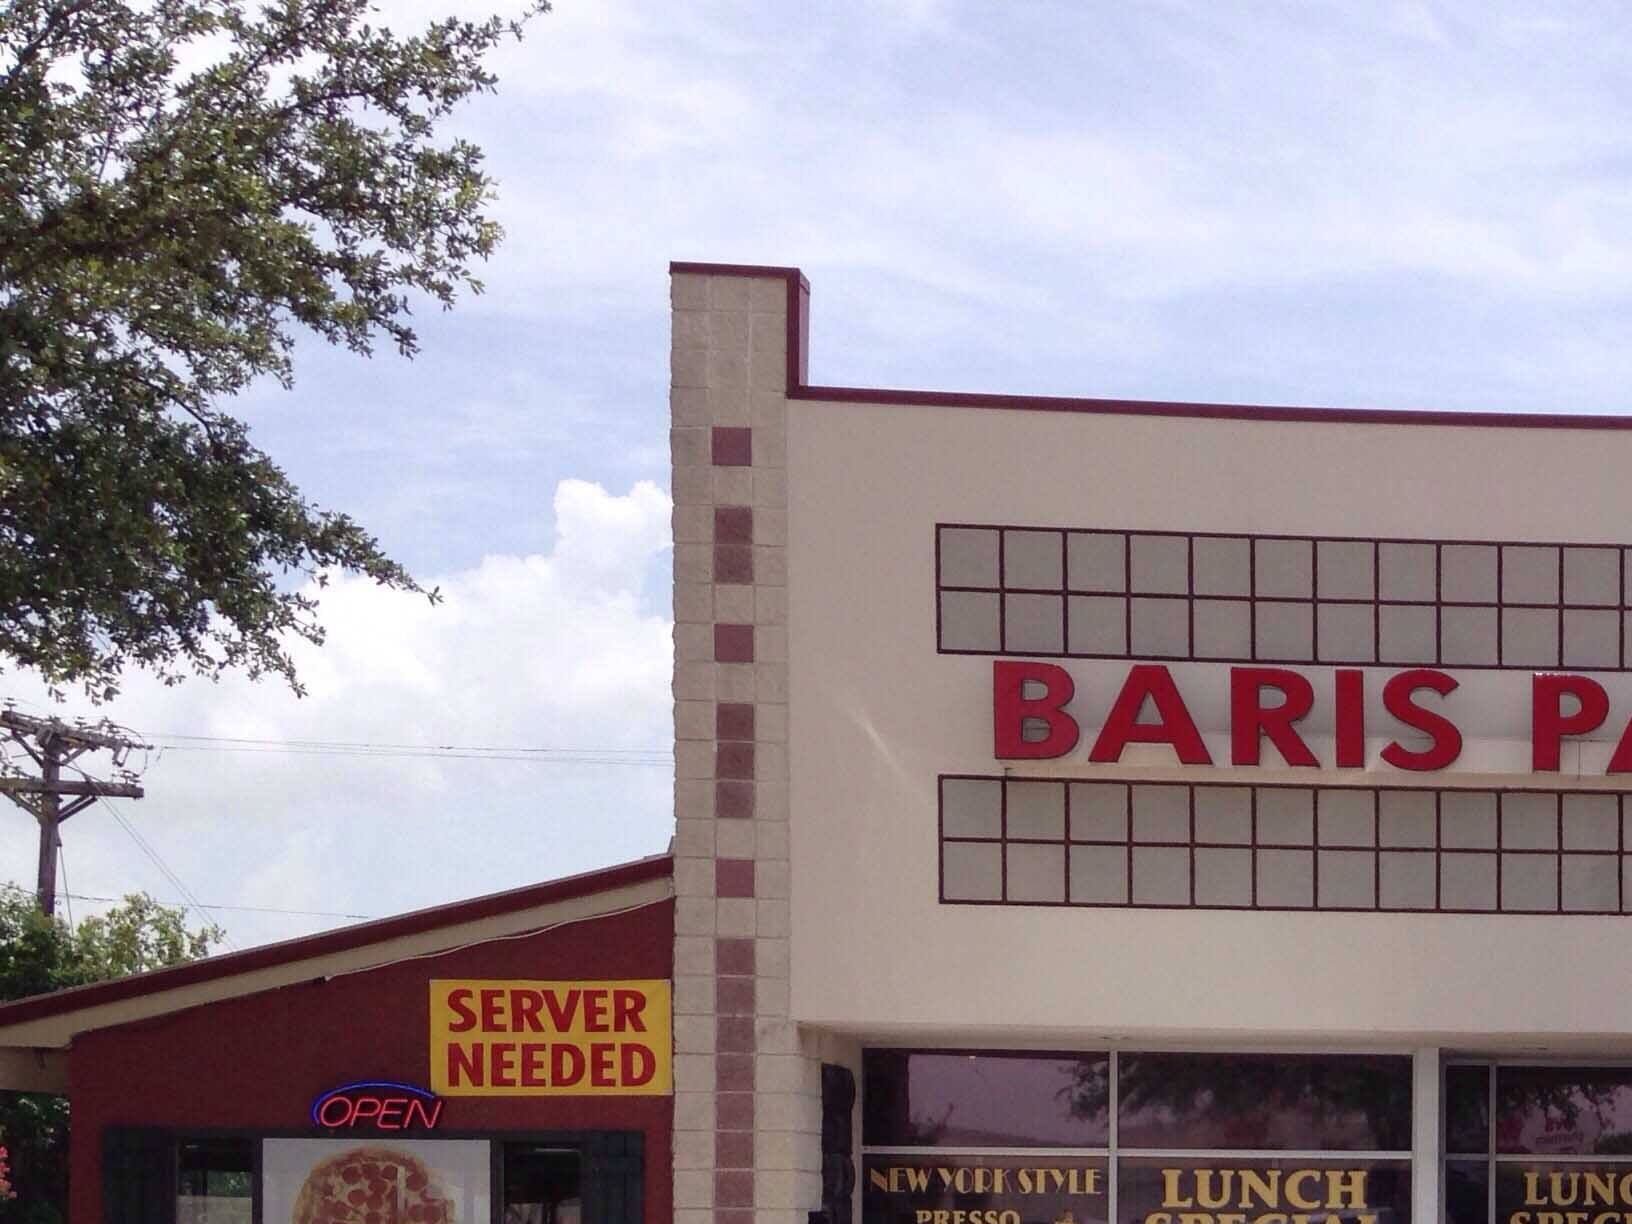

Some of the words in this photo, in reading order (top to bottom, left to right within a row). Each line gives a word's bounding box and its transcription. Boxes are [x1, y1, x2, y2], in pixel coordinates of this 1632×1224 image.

[993, 660, 1463, 772] BARIS
[447, 988, 648, 1034] SERVER
[447, 1042, 657, 1088] NEEDED
[318, 1096, 443, 1130] OPEN
[870, 1167, 932, 1194] NEW
[936, 1167, 1013, 1194] YORK
[1017, 1168, 1102, 1195] STYLE
[1161, 1169, 1368, 1209] LUNCH
